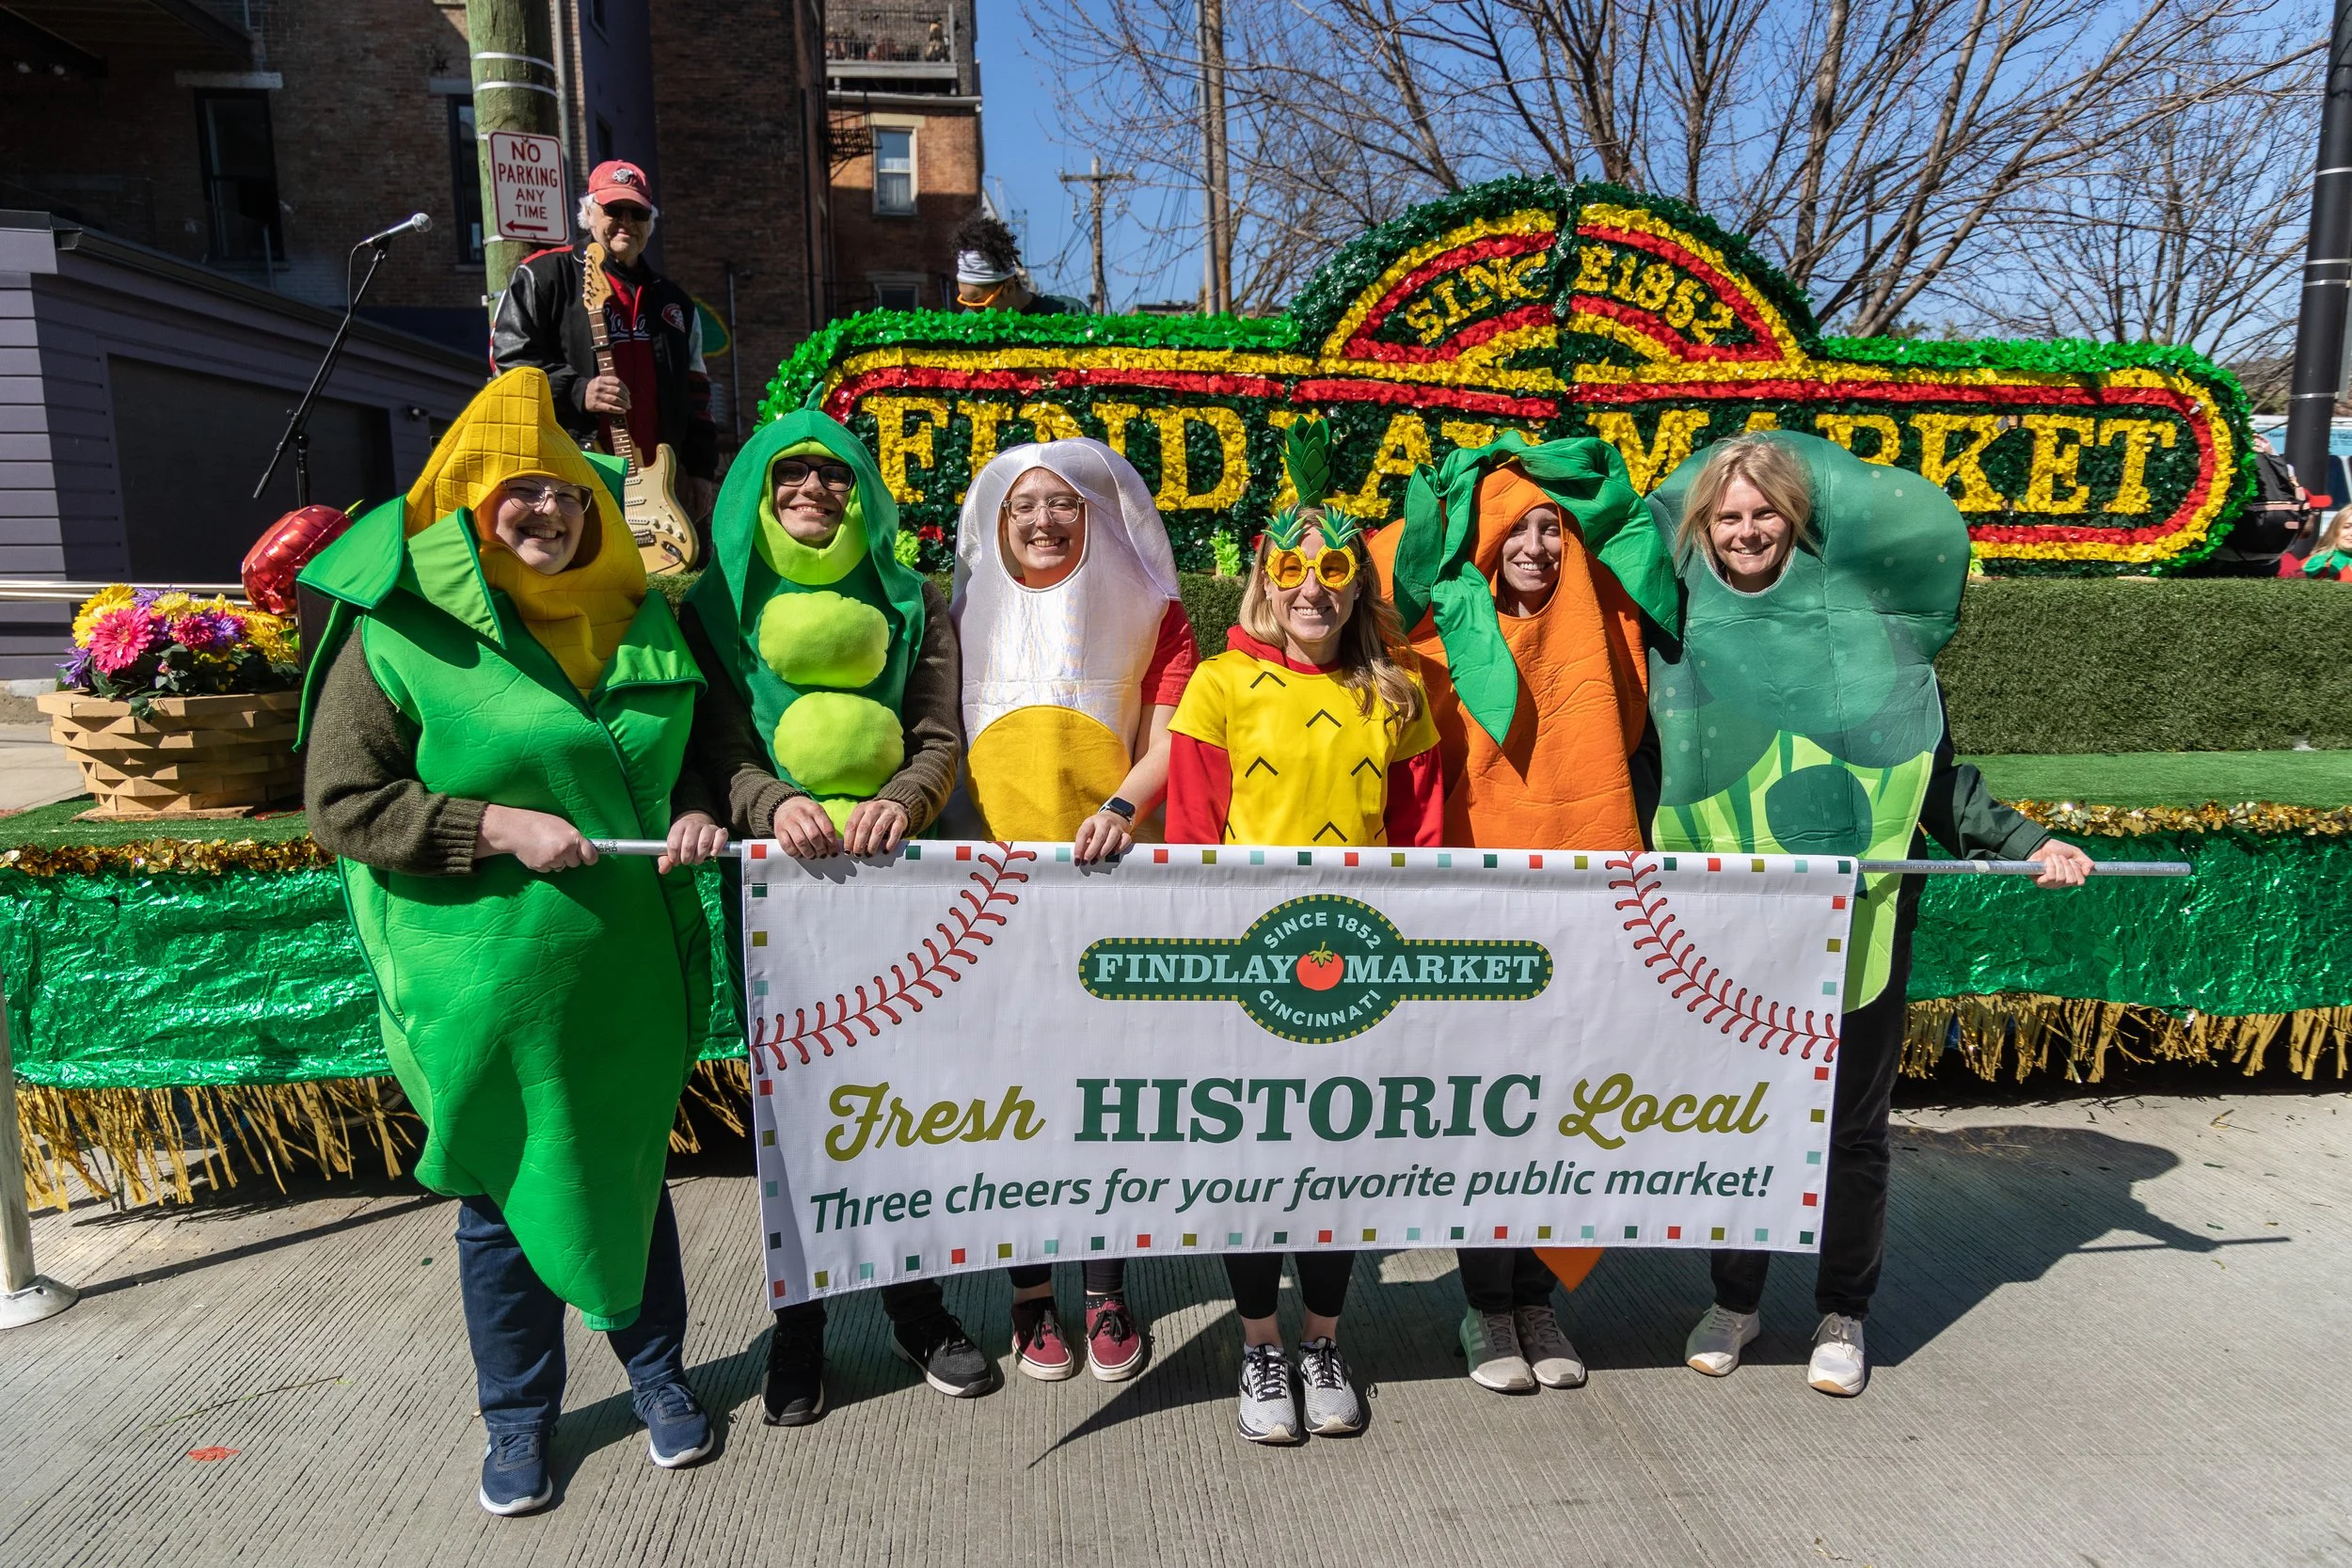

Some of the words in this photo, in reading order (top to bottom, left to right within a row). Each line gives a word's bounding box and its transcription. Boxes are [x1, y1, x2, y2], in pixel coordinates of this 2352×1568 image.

[511, 141, 541, 163] NO
[498, 163, 558, 188] PARKING
[515, 204, 548, 219] TIME
[516, 188, 545, 203] ANY
[1405, 245, 1615, 344] SINCE
[1611, 254, 1734, 345] 1852
[861, 396, 1544, 519] FINDA
[1586, 408, 2176, 515] MKET
[1263, 911, 1327, 950] SINCE
[1336, 913, 1382, 950] 1852
[1094, 953, 1297, 983] FINDLAY
[1343, 954, 1540, 984] MARKET
[1258, 989, 1382, 1028] CINCINNATI
[824, 1081, 1046, 1163] Fresh
[1074, 1074, 1541, 1144] HISTORIC
[1558, 1072, 1771, 1150] Local
[810, 1186, 932, 1234] Three
[946, 1172, 1091, 1212] cheers
[1095, 1167, 1170, 1215] for
[1174, 1175, 1283, 1214] your
[1283, 1163, 1455, 1212] favorite
[1462, 1160, 1596, 1207] public
[1604, 1161, 1774, 1198] market!
